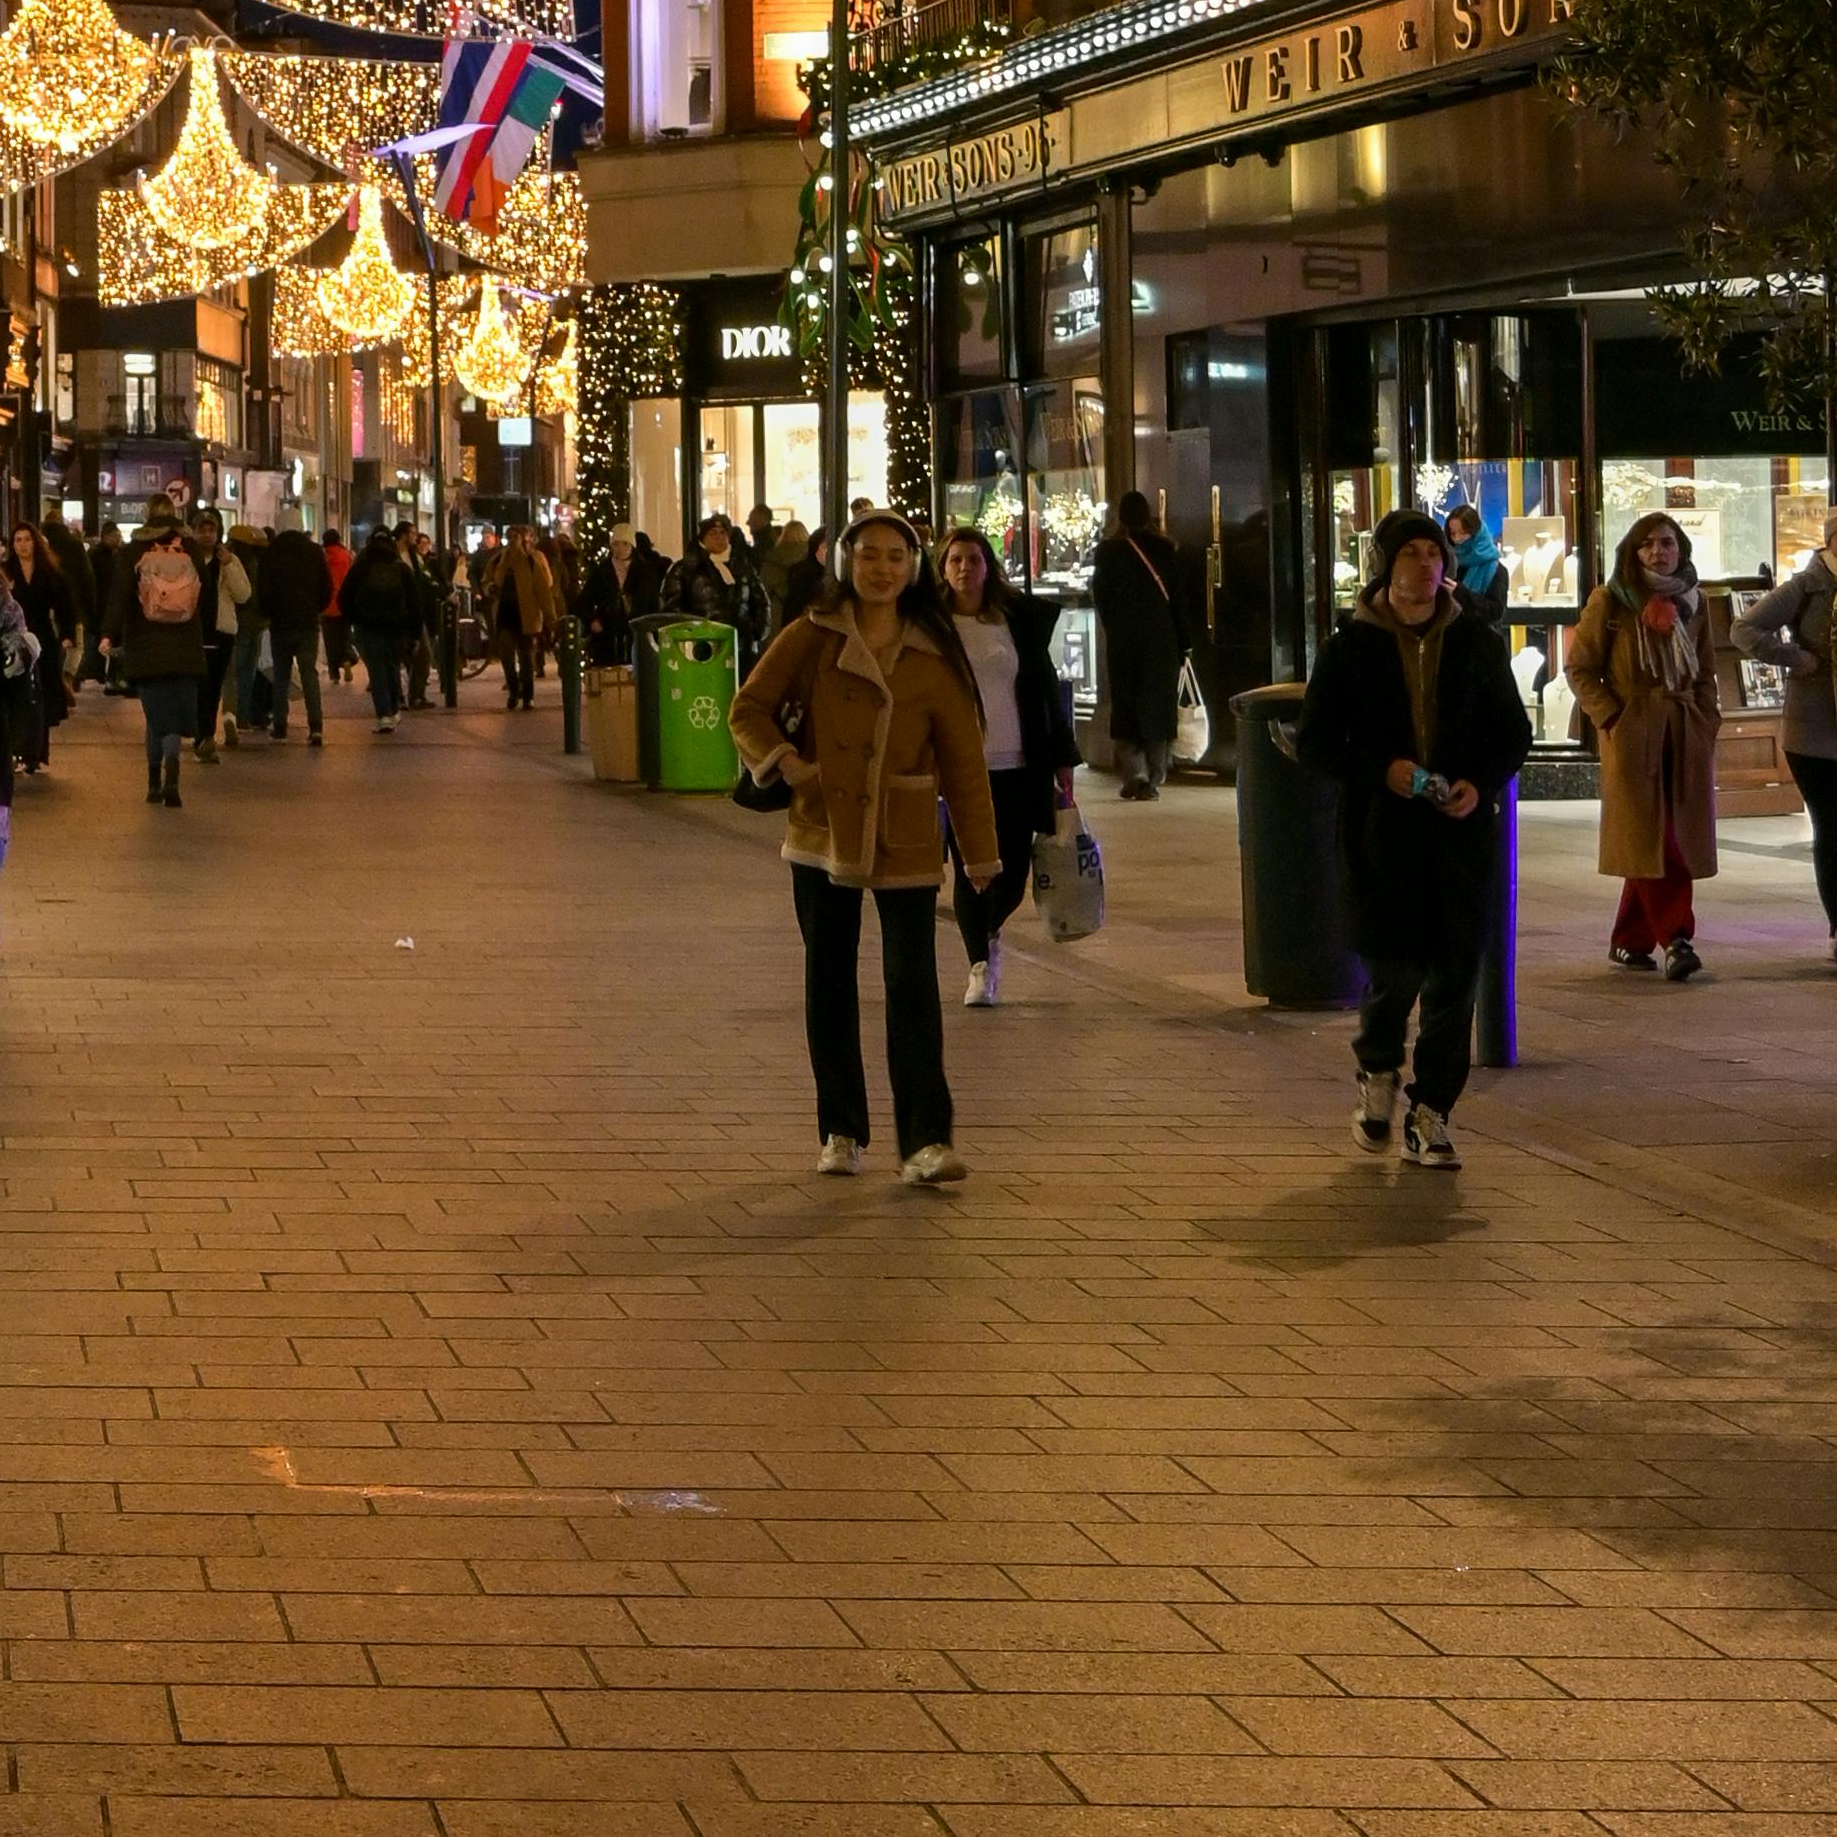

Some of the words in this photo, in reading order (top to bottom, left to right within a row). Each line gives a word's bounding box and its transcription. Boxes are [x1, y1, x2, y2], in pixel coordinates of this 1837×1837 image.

[1221, 24, 1365, 113] WEIR
[1397, 19, 1419, 53] &
[888, 156, 942, 212] WEIR
[951, 132, 1015, 194] SONS
[721, 326, 791, 359] DIOR
[1796, 414, 1814, 431] &
